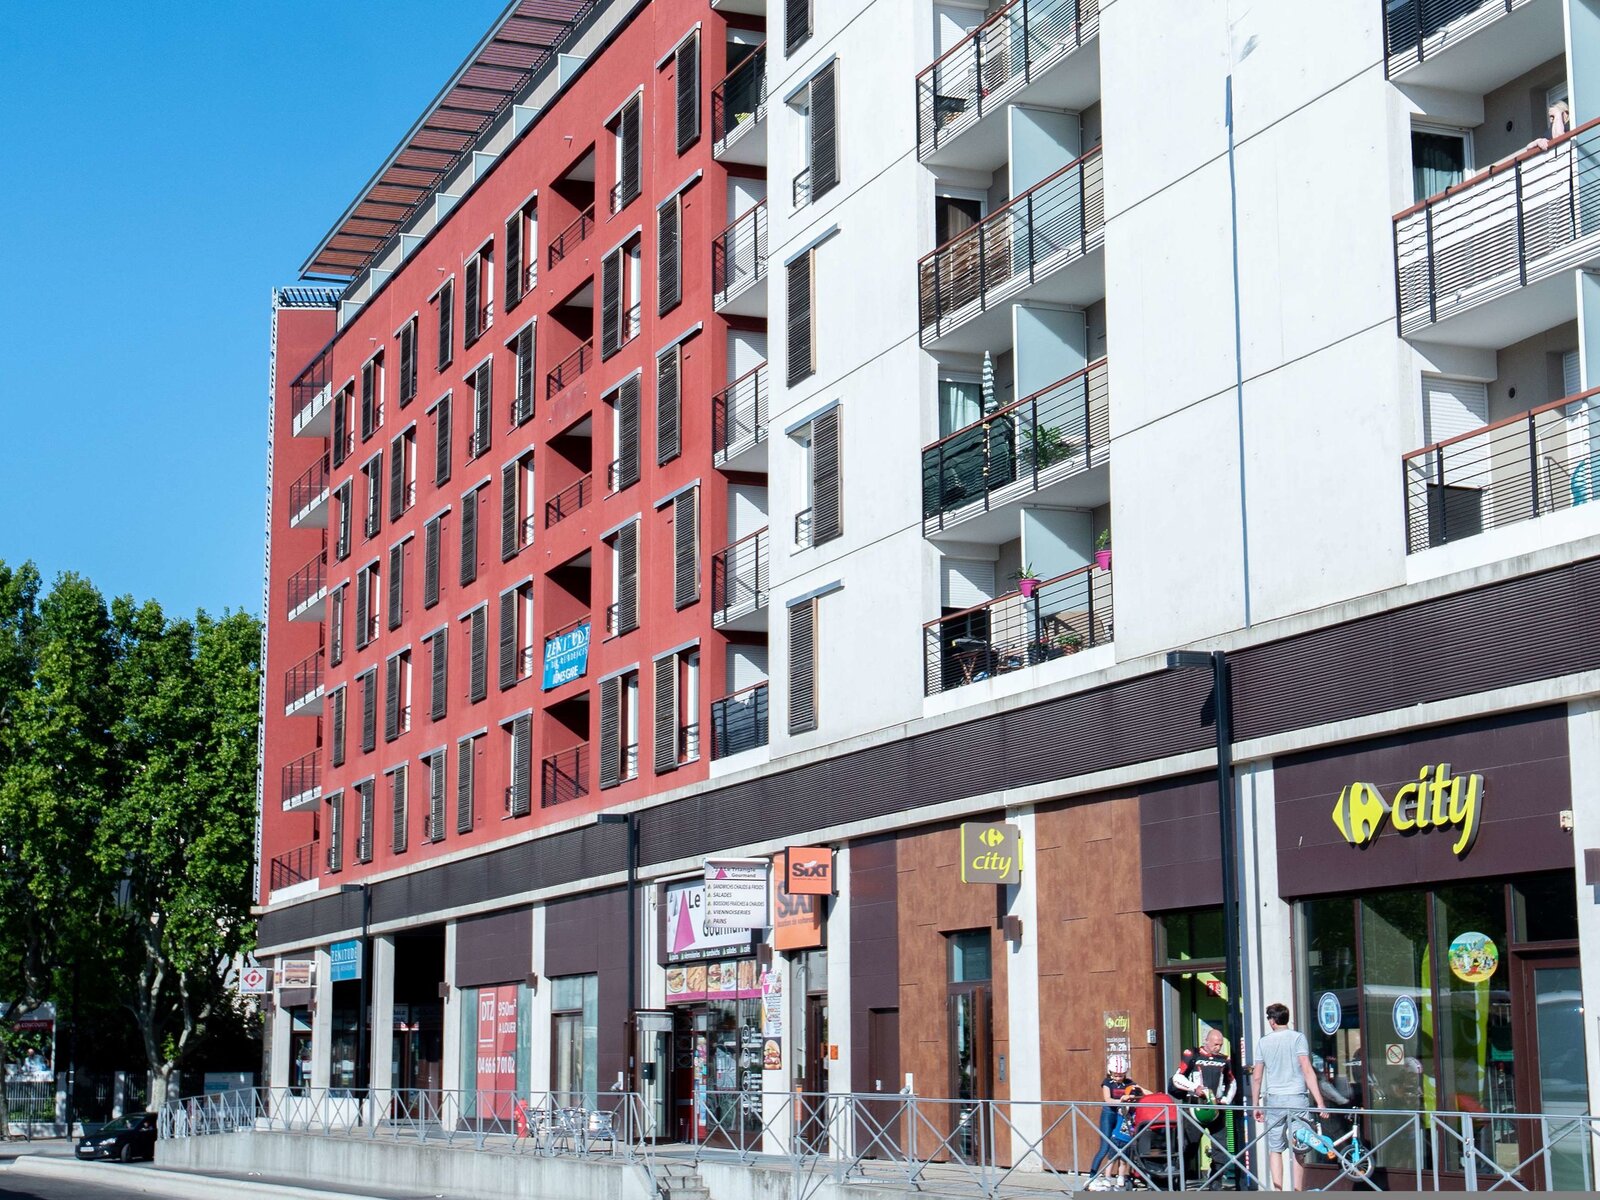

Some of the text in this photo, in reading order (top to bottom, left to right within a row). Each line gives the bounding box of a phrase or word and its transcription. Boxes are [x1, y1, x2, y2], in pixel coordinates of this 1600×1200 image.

[1391, 763, 1482, 855] city
[972, 851, 1012, 879] city
[688, 891, 700, 909] Le
[331, 946, 357, 962] ZENITUDE
[481, 1000, 494, 1021] DTZ
